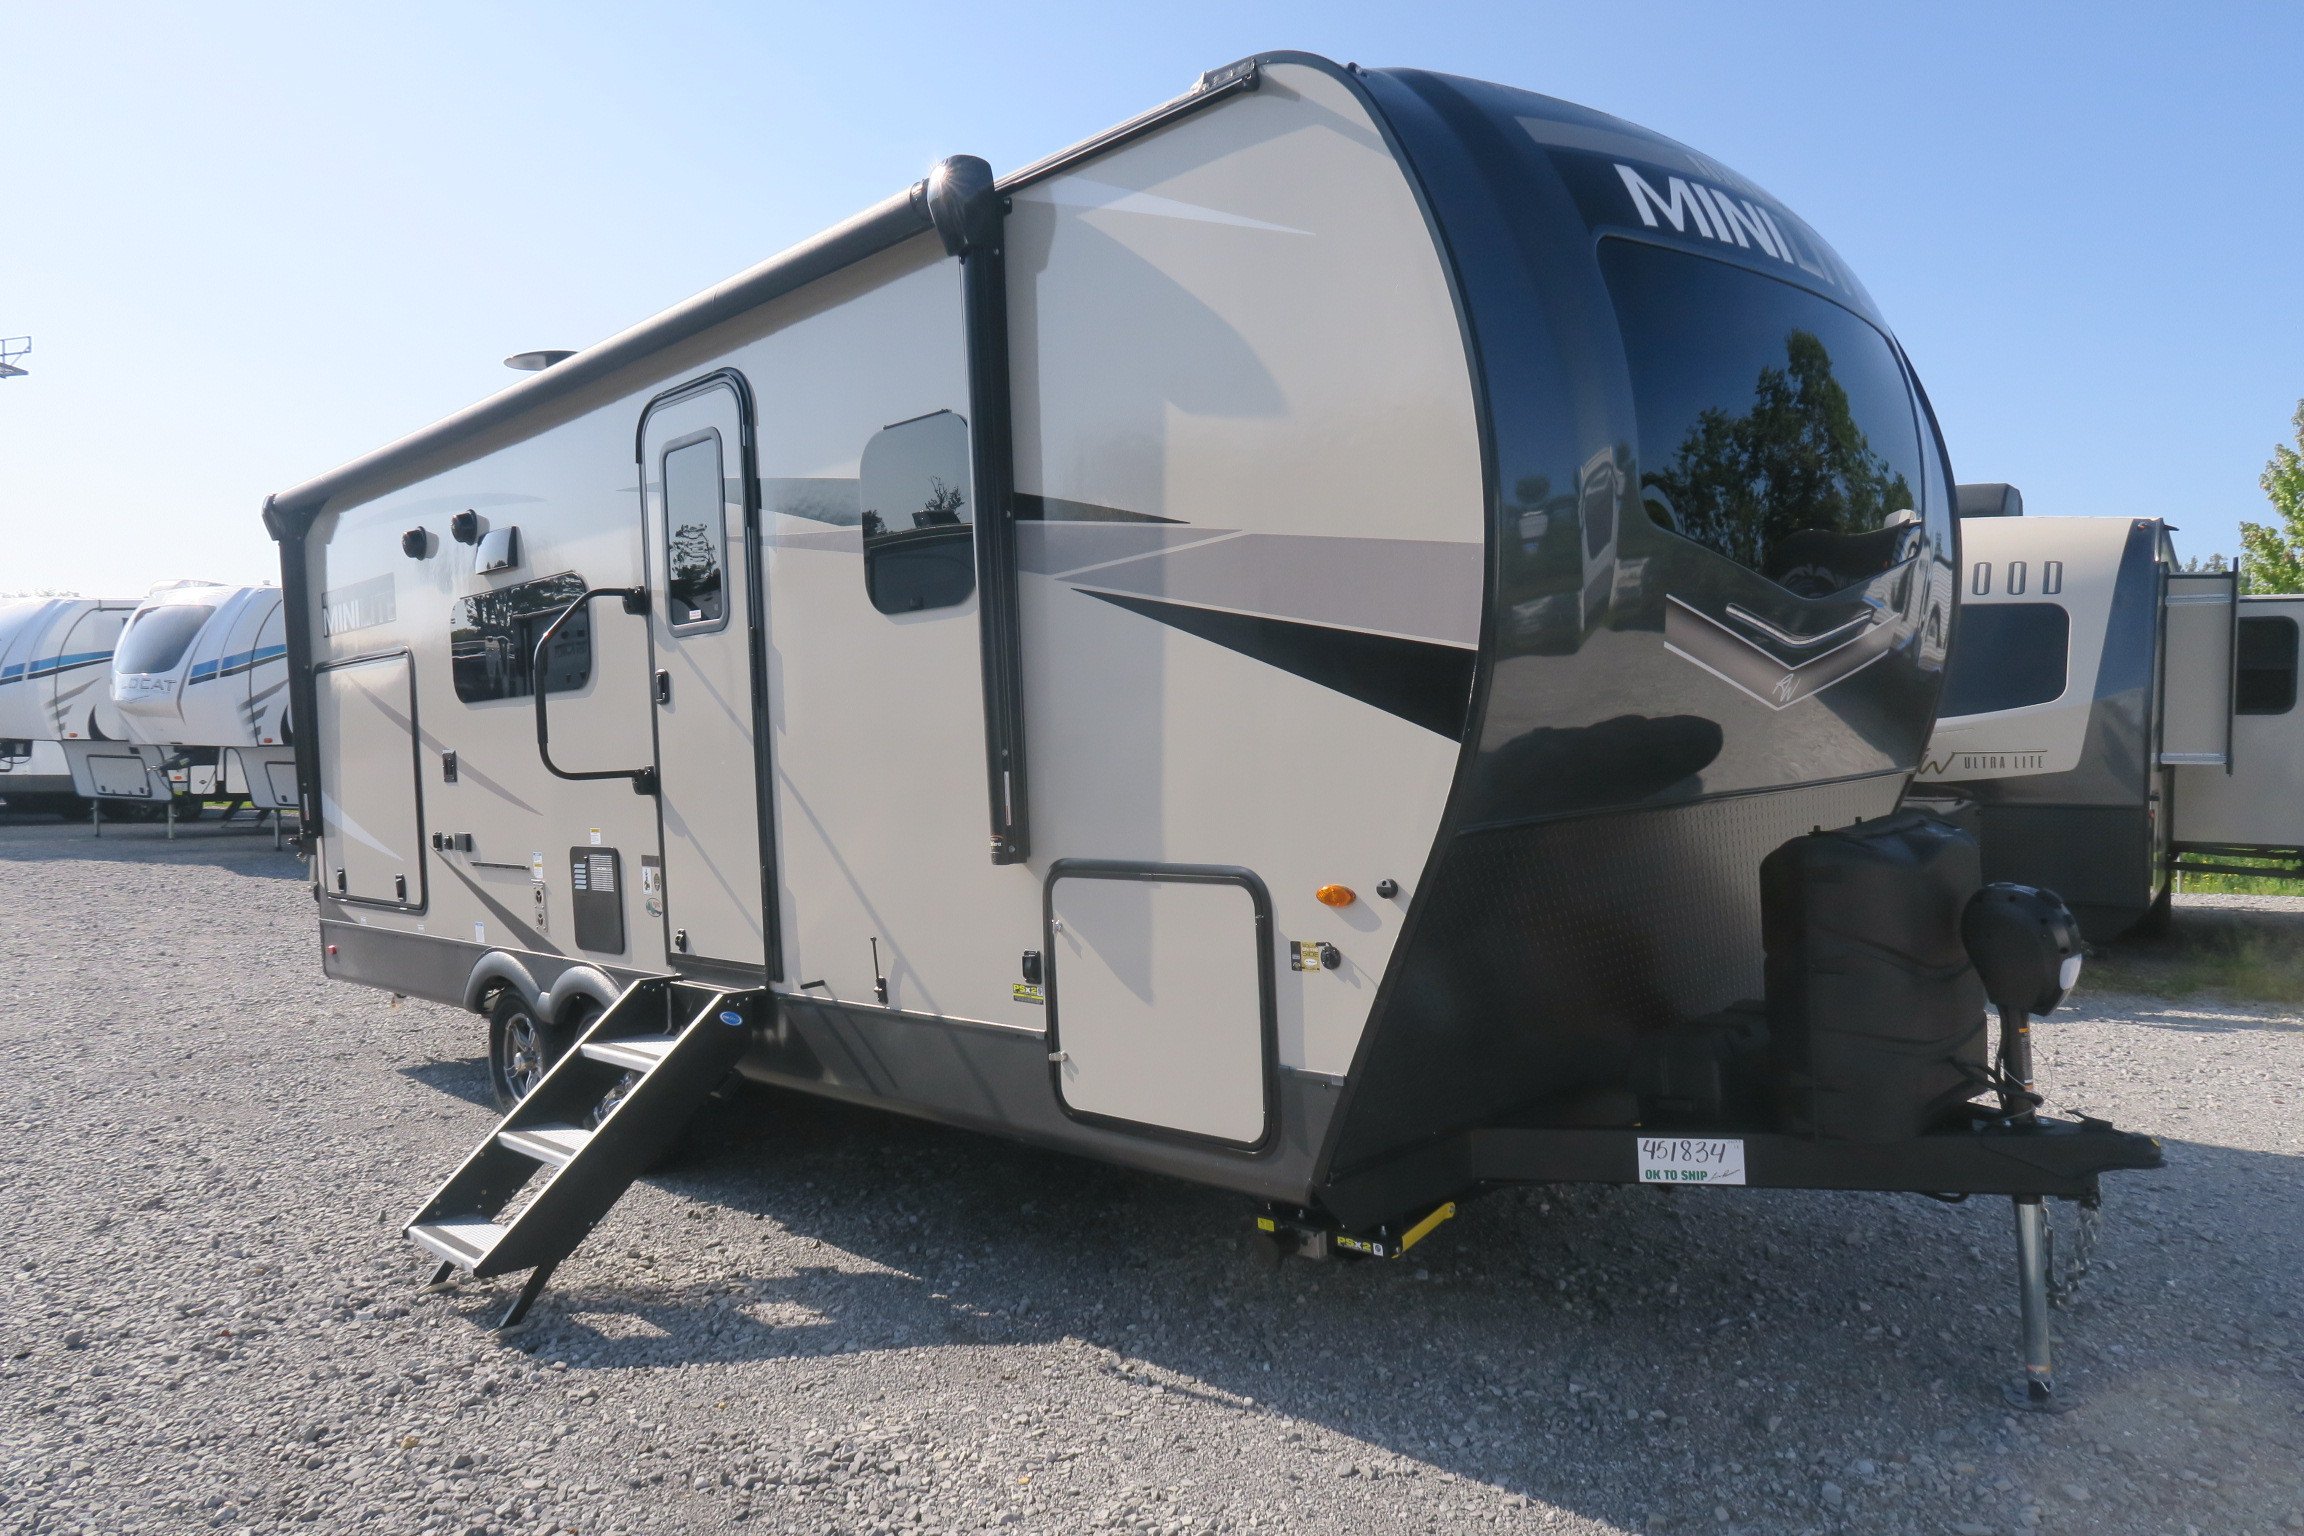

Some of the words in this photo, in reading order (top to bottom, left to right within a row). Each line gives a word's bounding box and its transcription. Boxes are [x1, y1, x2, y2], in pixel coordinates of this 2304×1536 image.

[1613, 163, 1794, 265] MINI
[322, 599, 360, 637] MINI
[1964, 755, 2006, 770] ULTRA
[2014, 755, 2044, 769] LITE
[1642, 1139, 1726, 1164] 451834
[1645, 1169, 1661, 1180] OK
[1664, 1170, 1678, 1181] TO
[1681, 1170, 1708, 1181] SHIP
